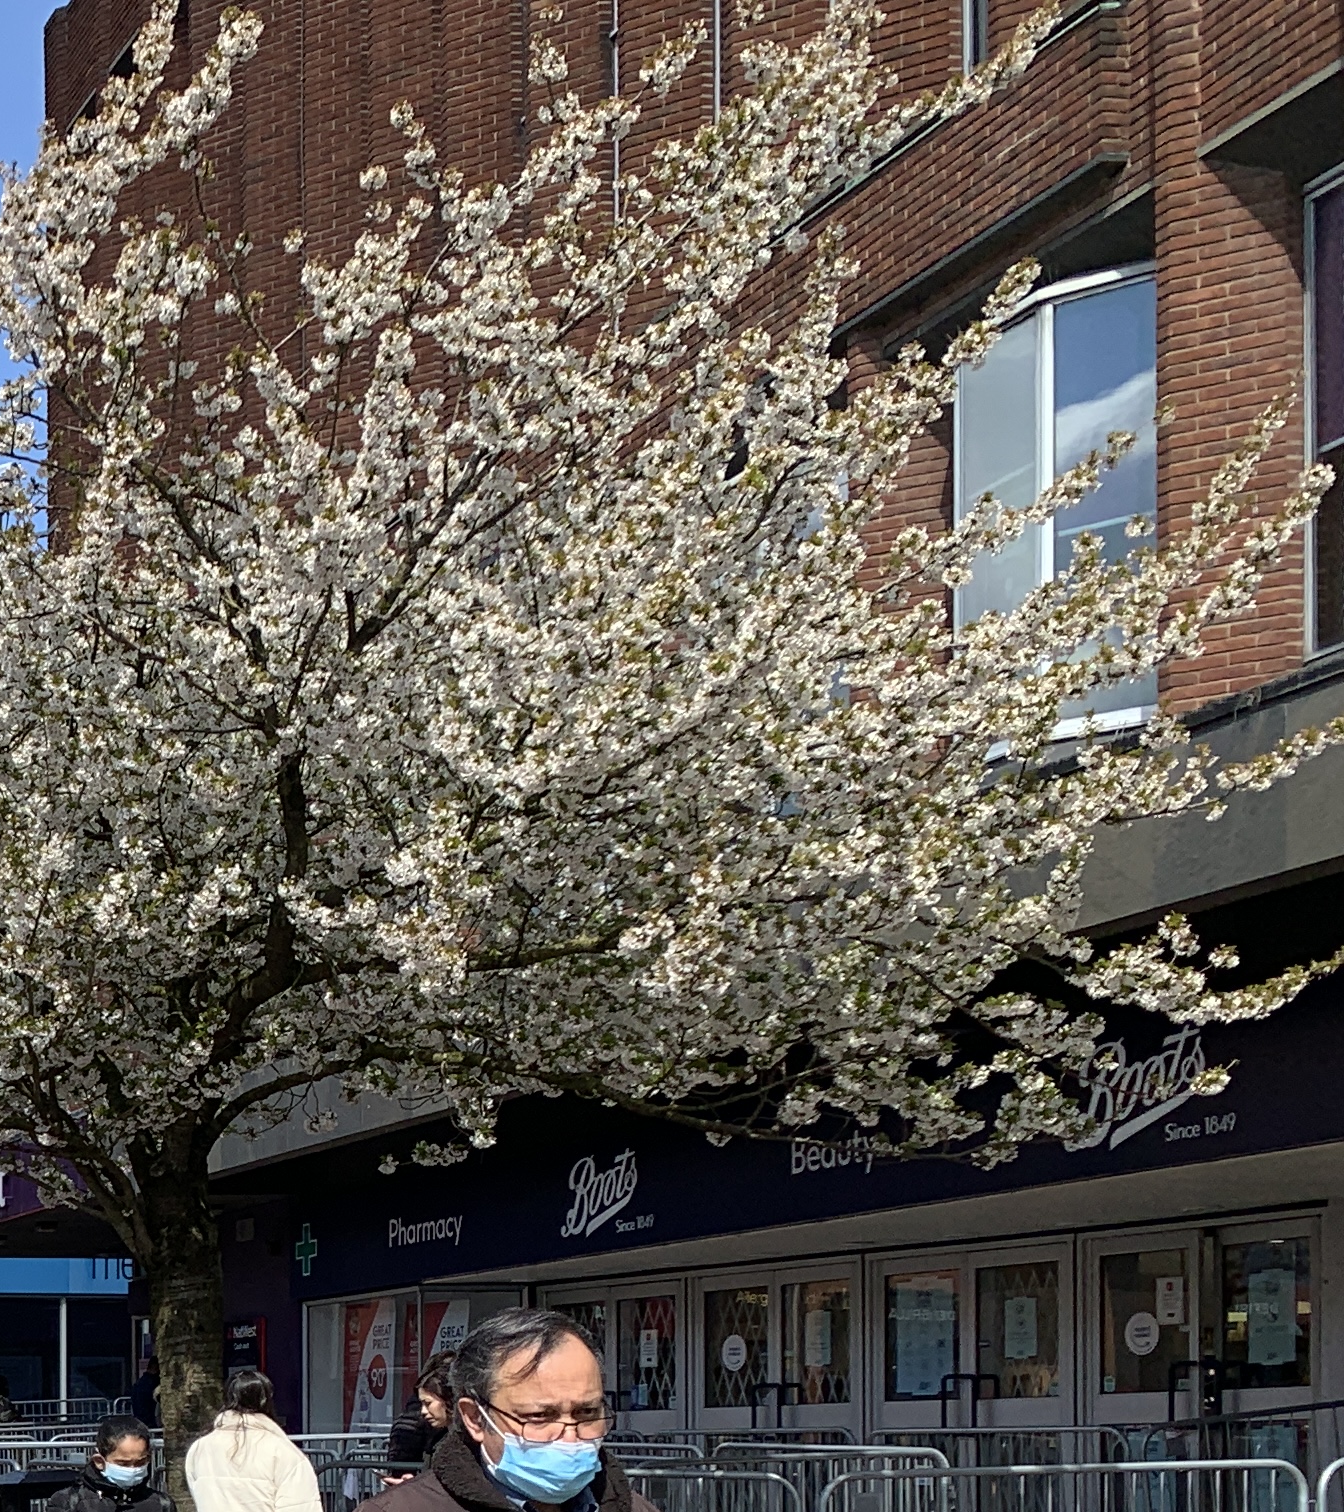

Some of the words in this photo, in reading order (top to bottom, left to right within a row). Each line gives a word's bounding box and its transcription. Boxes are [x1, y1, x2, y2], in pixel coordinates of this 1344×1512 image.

[1065, 1024, 1208, 1152] Boots
[1164, 1122, 1201, 1142] Since
[1203, 1112, 1237, 1135] 1849
[791, 1129, 873, 1175] Beauty
[561, 1148, 638, 1238] Boots
[388, 1215, 463, 1248] Pharmacy
[615, 1218, 635, 1233] Since
[636, 1213, 655, 1231] 1849
[372, 1323, 392, 1337] GREAT
[372, 1338, 390, 1350] PRICE
[440, 1325, 465, 1339] GREAT
